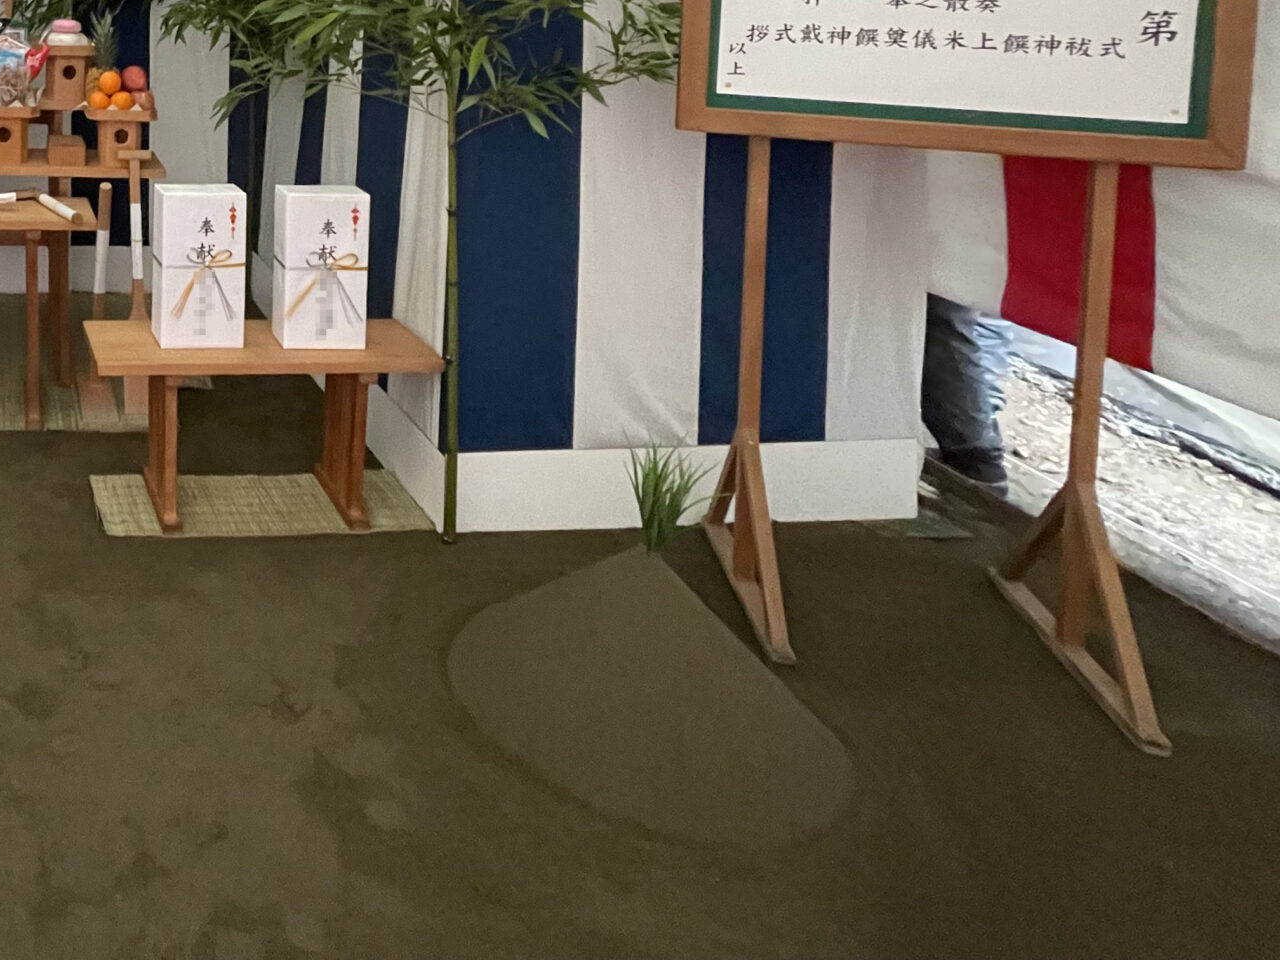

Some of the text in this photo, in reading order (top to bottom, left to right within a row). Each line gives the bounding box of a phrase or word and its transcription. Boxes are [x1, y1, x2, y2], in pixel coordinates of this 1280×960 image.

[727, 42, 747, 76] 以上
[197, 216, 216, 262] 奉献
[319, 218, 337, 263] 奉献
